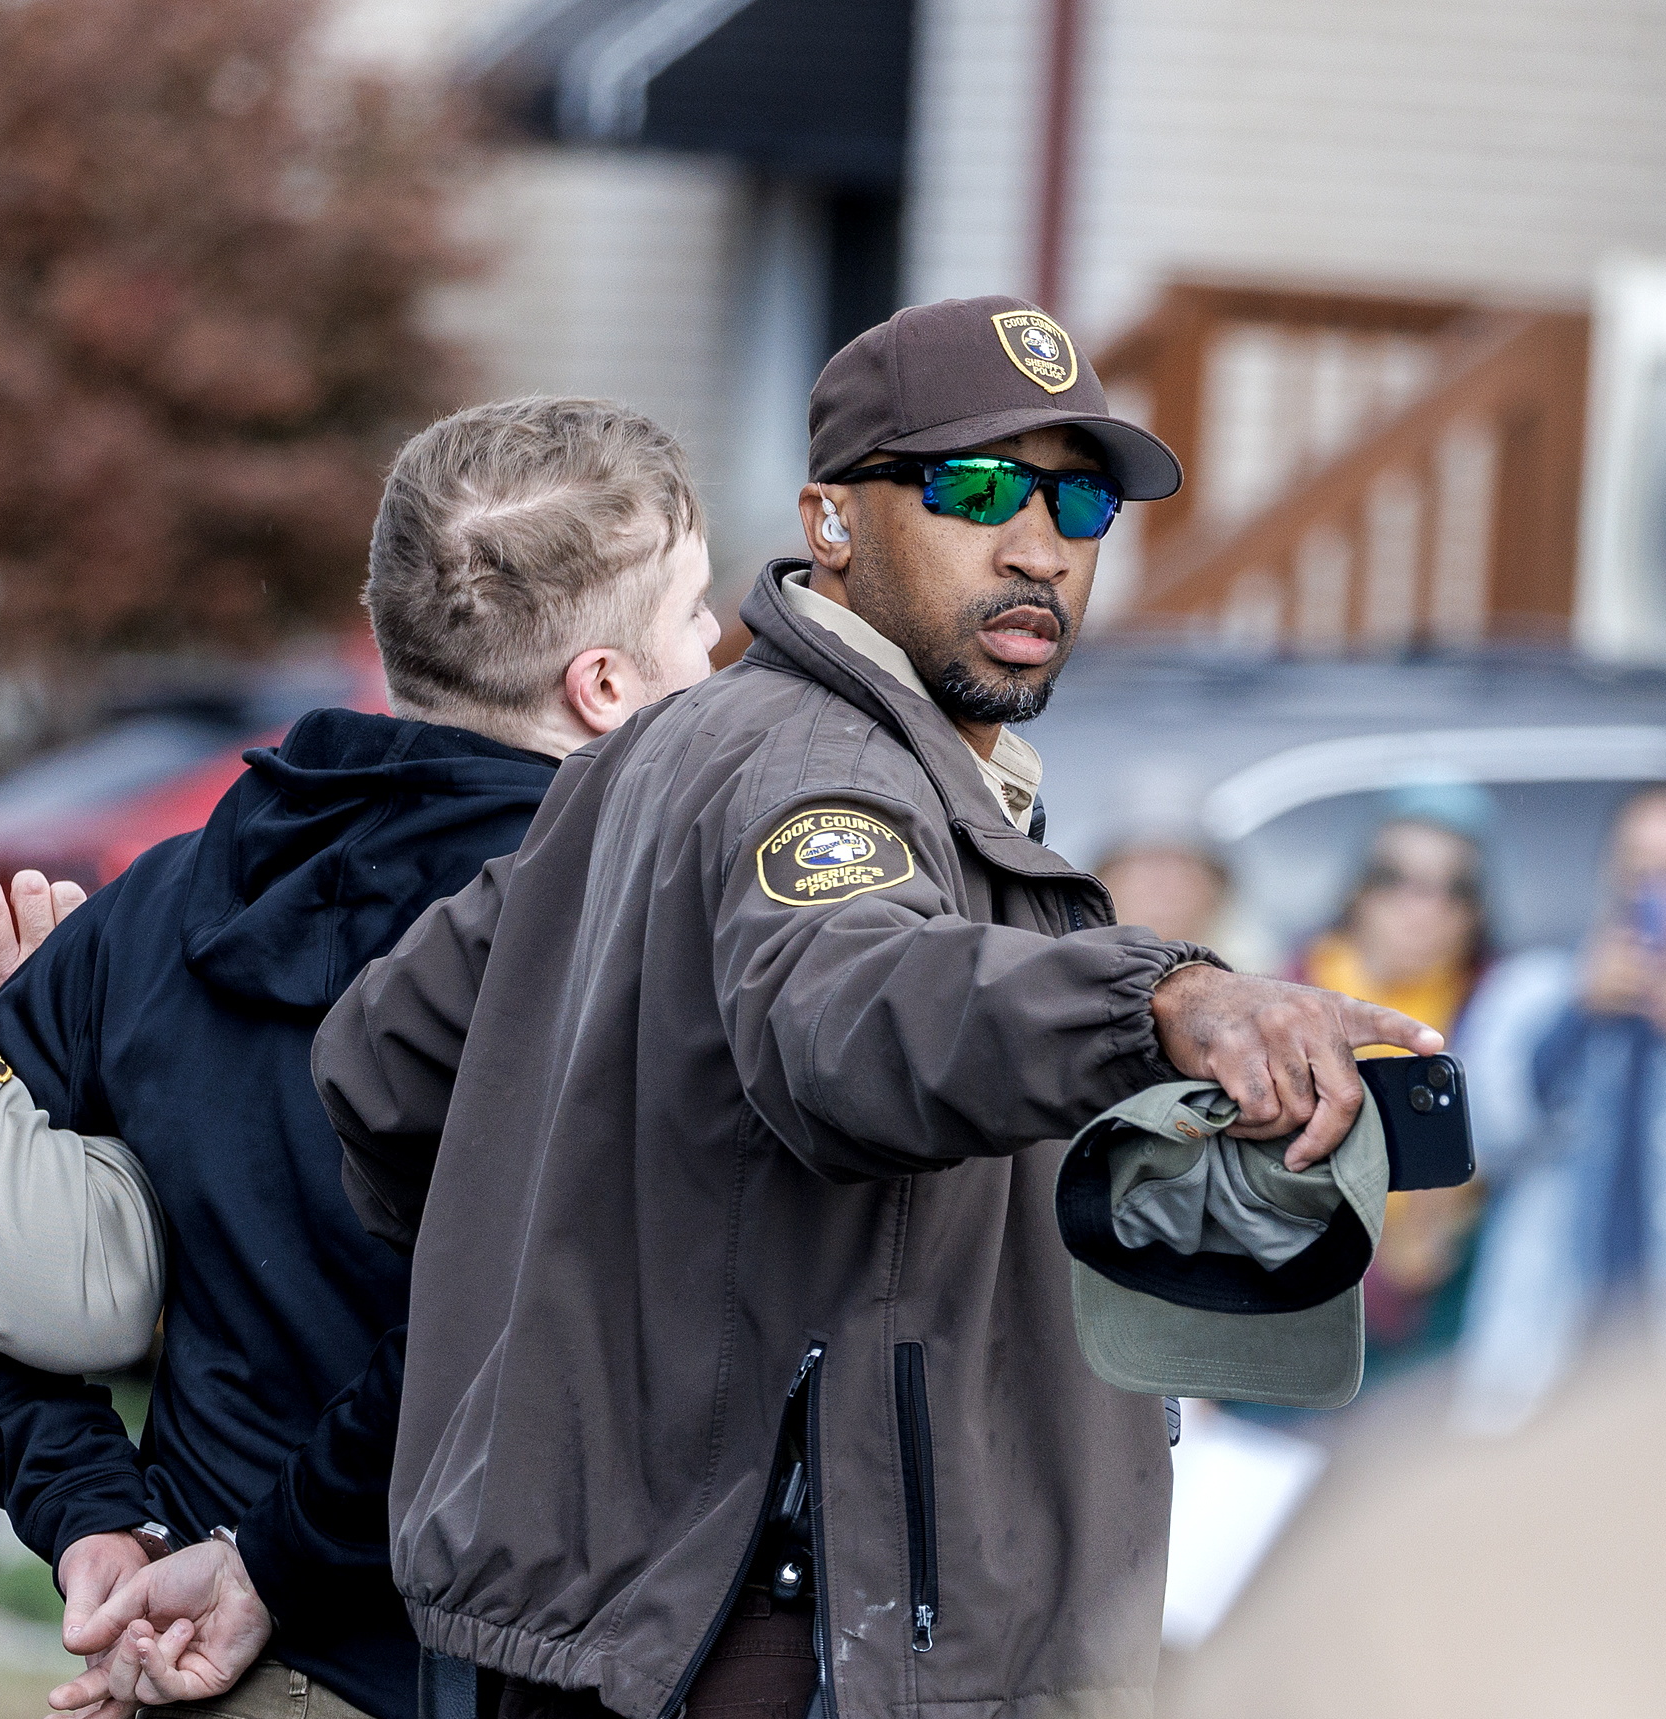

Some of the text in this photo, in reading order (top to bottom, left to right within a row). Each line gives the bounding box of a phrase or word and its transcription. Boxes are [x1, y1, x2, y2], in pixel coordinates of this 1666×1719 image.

[1003, 316, 1030, 329] COOK
[1030, 317, 1062, 341] COUNTY
[1024, 357, 1067, 376] SHERIFF'S
[1032, 366, 1064, 382] POLICE
[771, 815, 893, 854] COOK COUNTY
[795, 866, 885, 892] SHERIFF'S
[808, 874, 875, 896] POLICE
